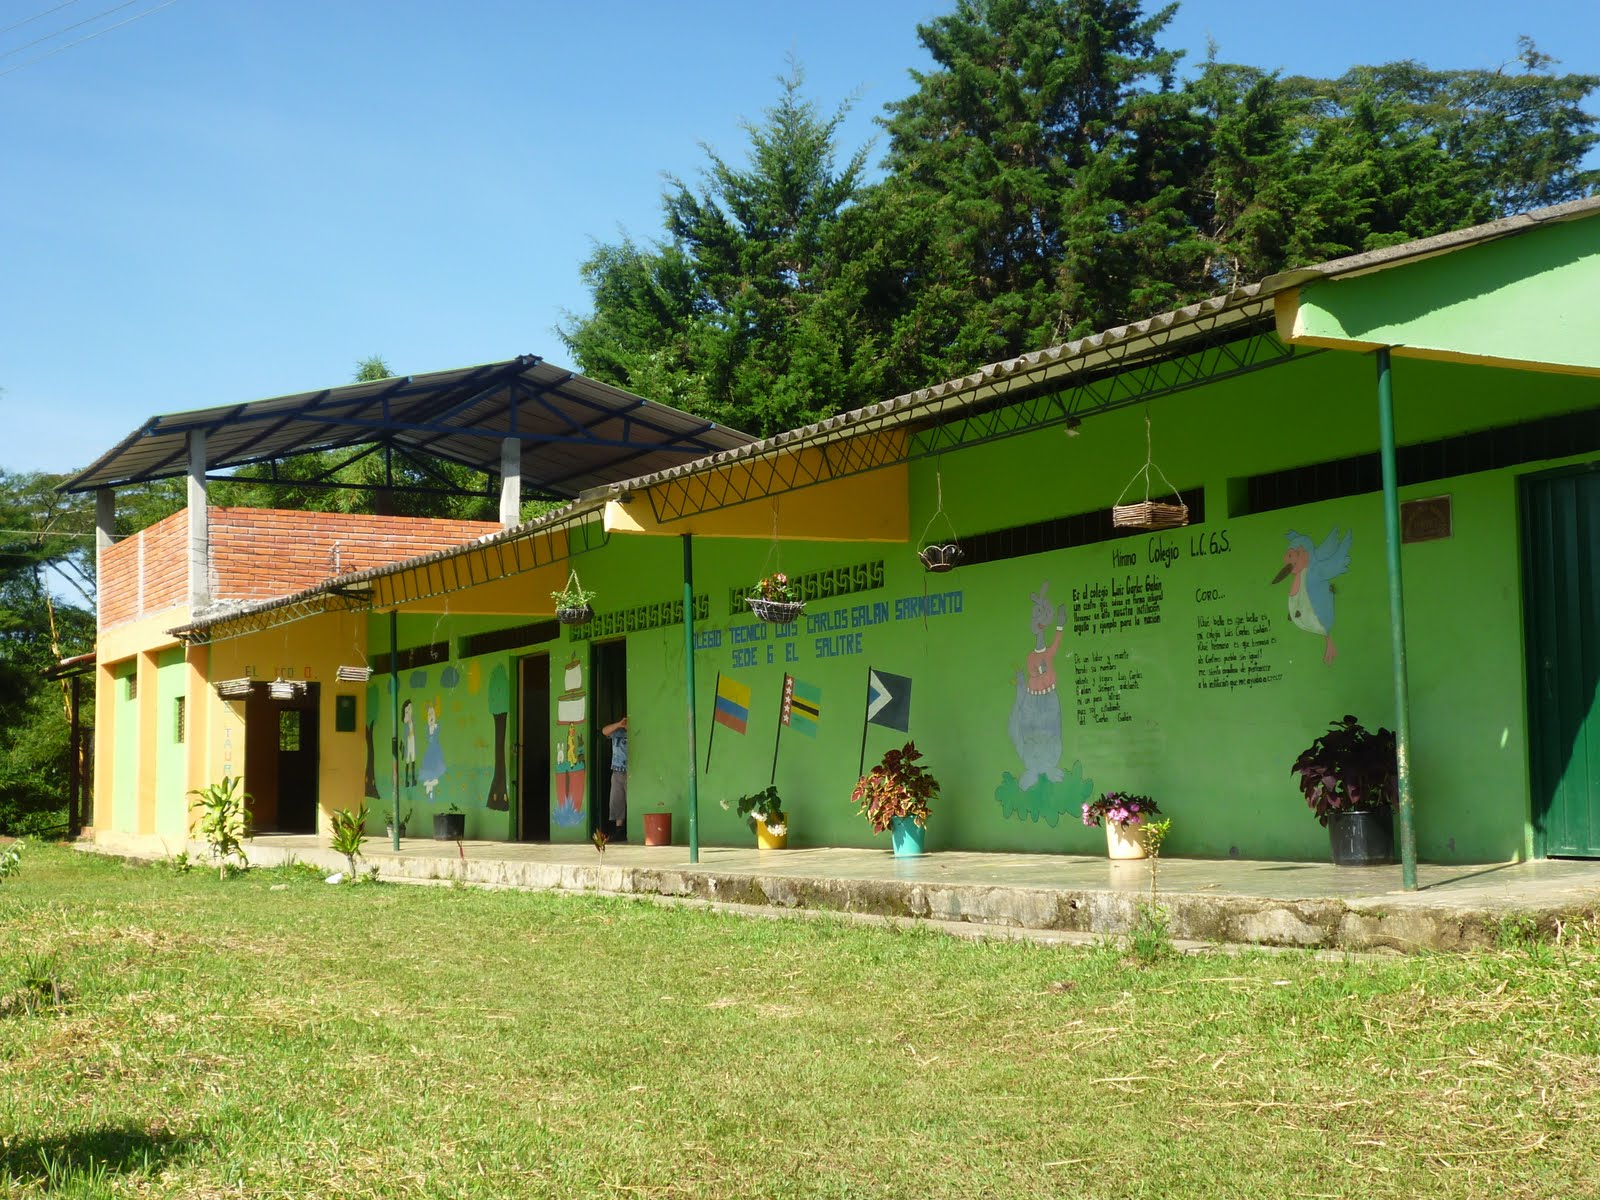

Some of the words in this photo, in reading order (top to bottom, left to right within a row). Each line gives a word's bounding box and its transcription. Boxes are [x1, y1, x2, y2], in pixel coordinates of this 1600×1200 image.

[1148, 537, 1179, 568] Colegio
[1090, 582, 1108, 601] colegio
[806, 608, 848, 634] CARLOS
[851, 601, 889, 628] GALAN
[895, 590, 963, 620] SARMIENTO
[732, 646, 758, 668] SEDE
[785, 642, 799, 662] EL
[815, 632, 863, 658] SALITRE
